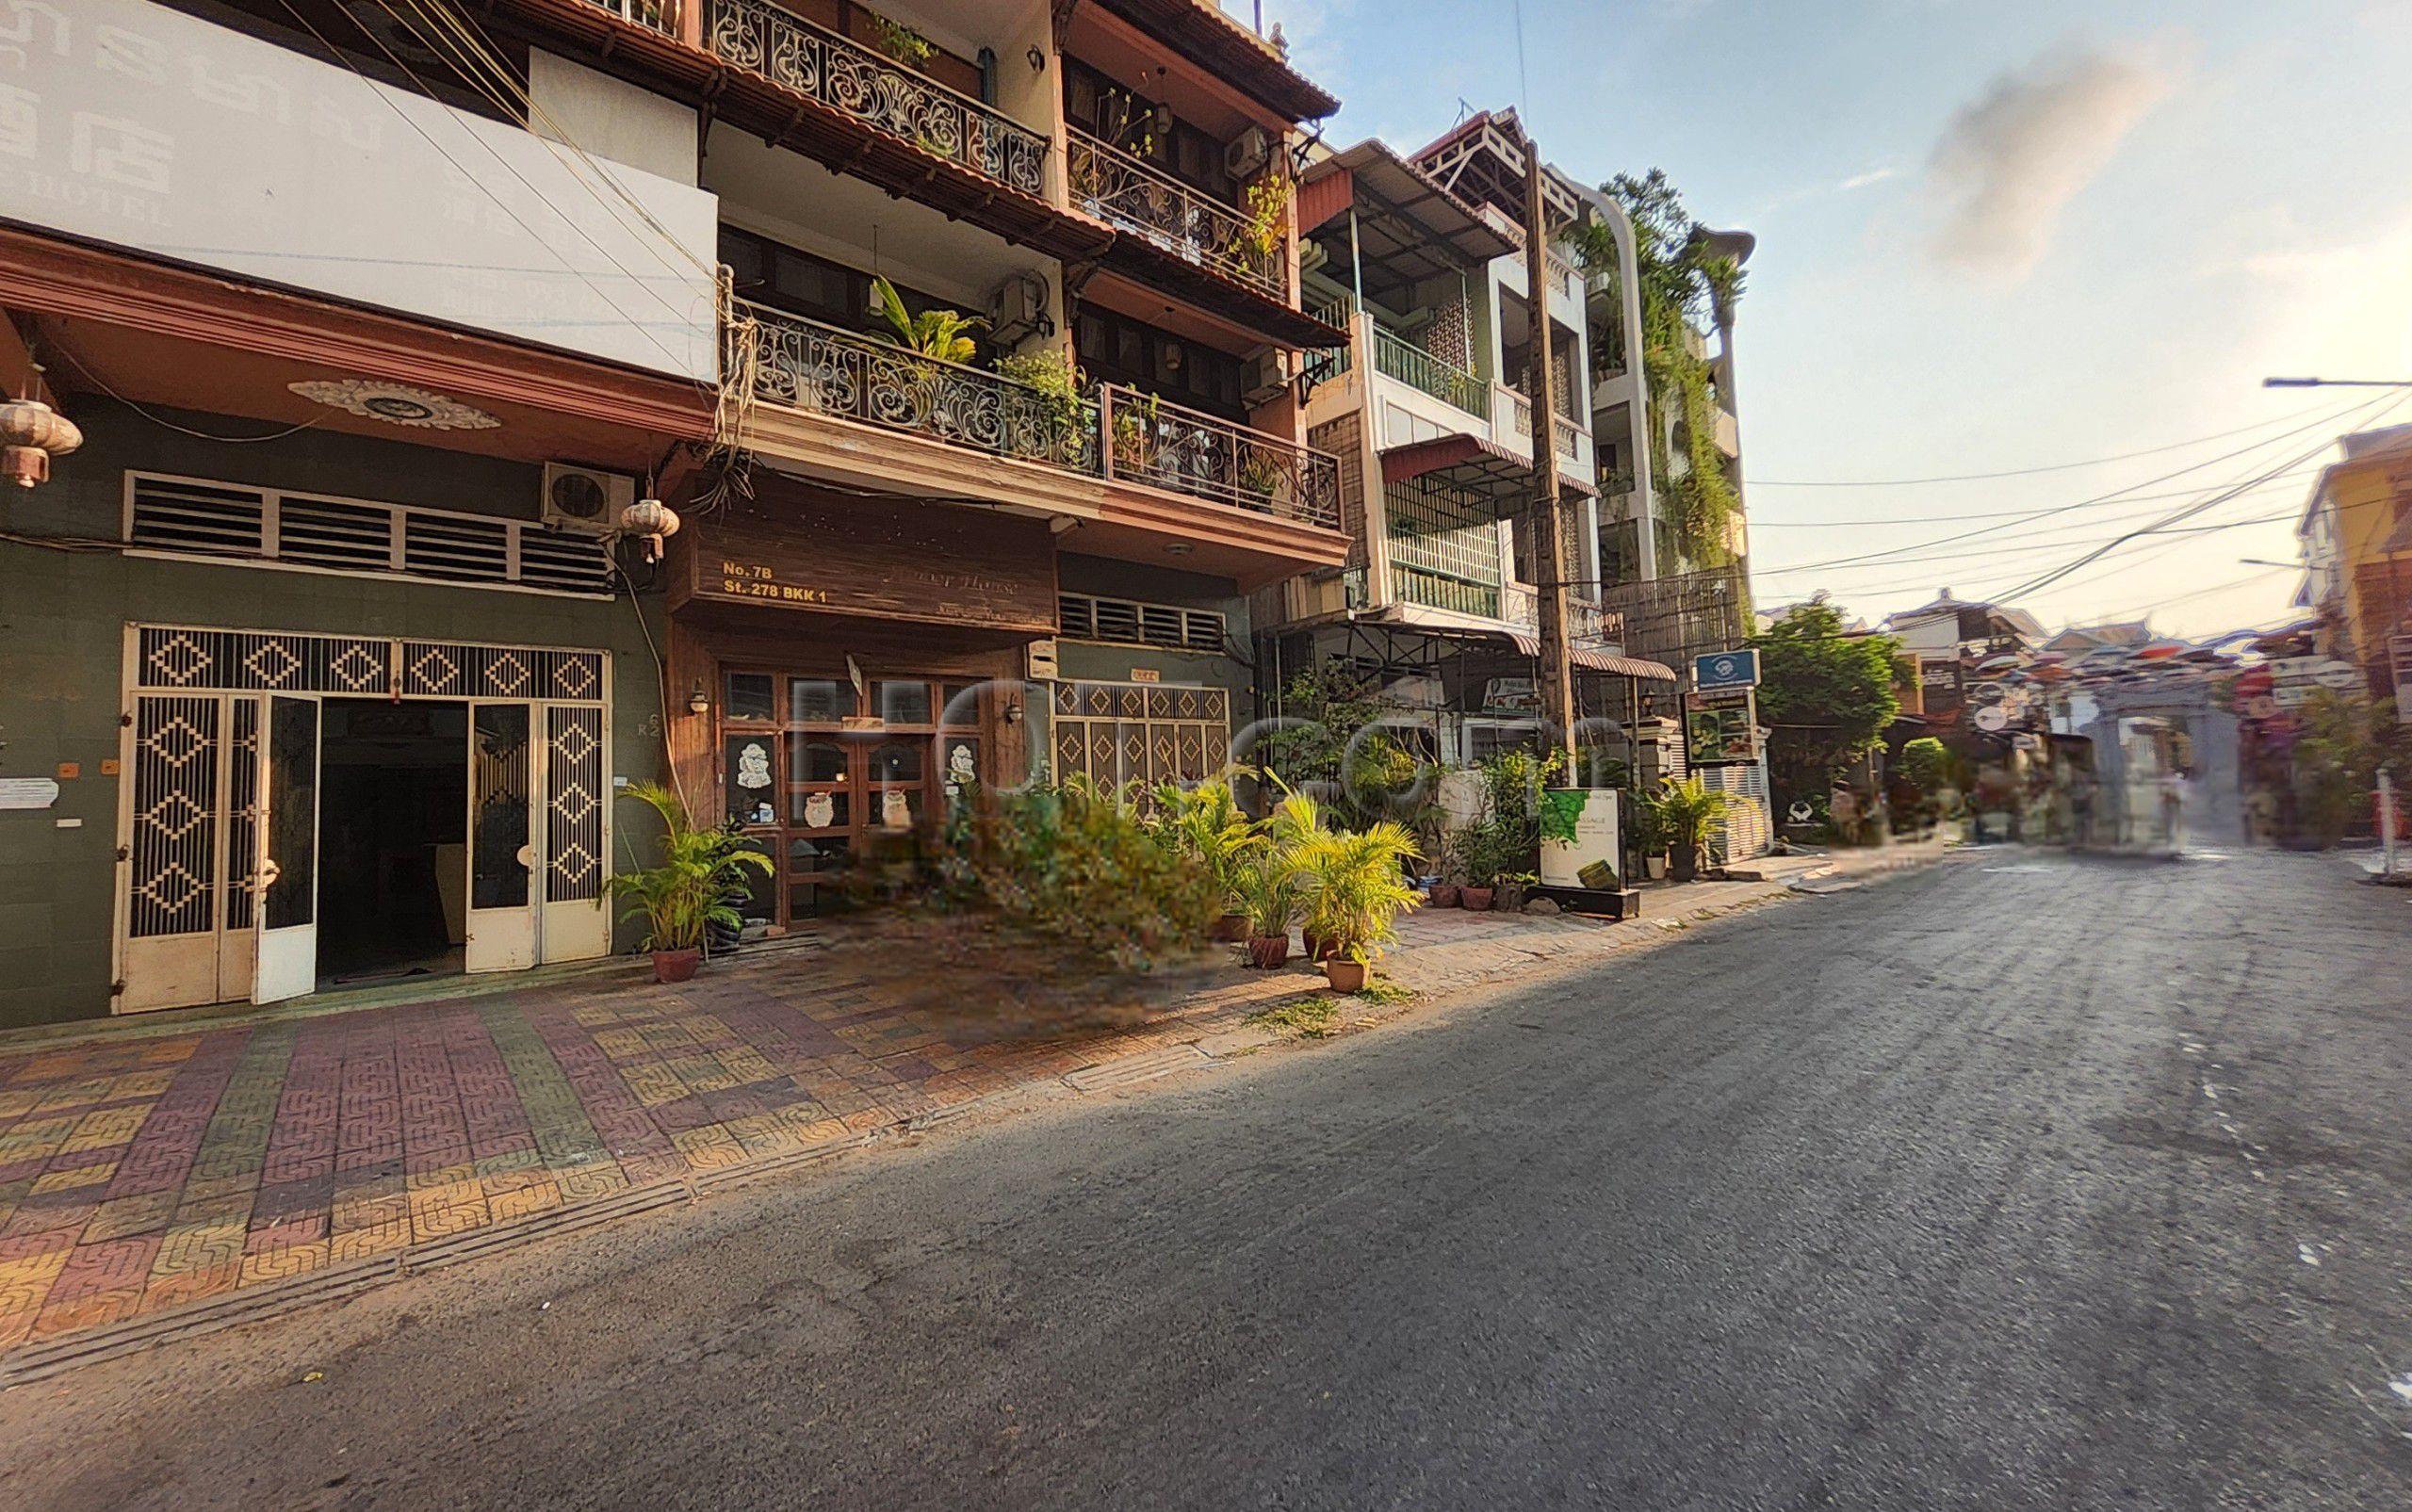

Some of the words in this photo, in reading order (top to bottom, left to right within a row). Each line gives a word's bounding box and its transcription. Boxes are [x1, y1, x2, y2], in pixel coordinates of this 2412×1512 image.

[723, 561, 750, 577] No.
[753, 566, 772, 579] 7B
[724, 580, 747, 593] St.
[752, 583, 778, 597] 278
[783, 587, 814, 601] BKK
[819, 592, 826, 603] 1
